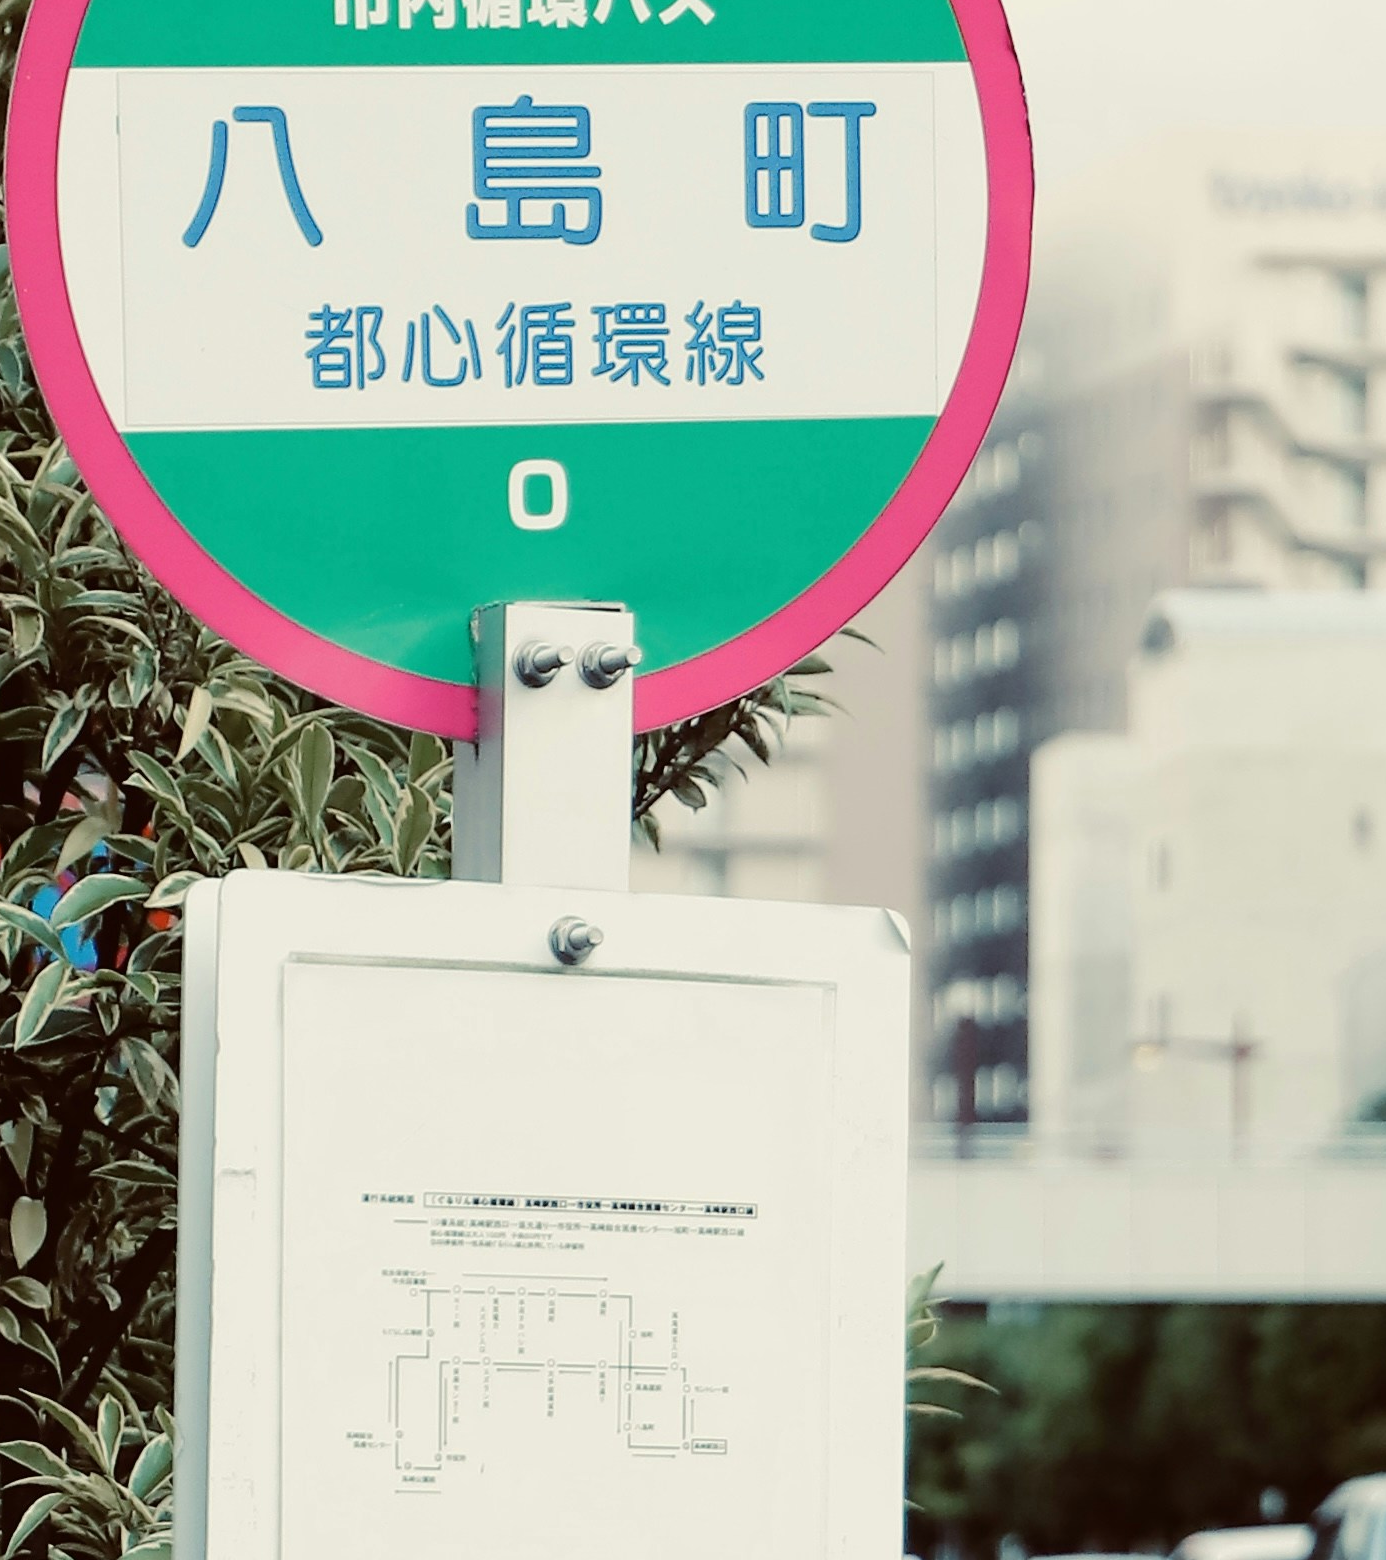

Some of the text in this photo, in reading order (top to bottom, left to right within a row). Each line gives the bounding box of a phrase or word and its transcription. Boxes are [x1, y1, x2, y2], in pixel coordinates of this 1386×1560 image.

[304, 298, 766, 390] 都心循環線
